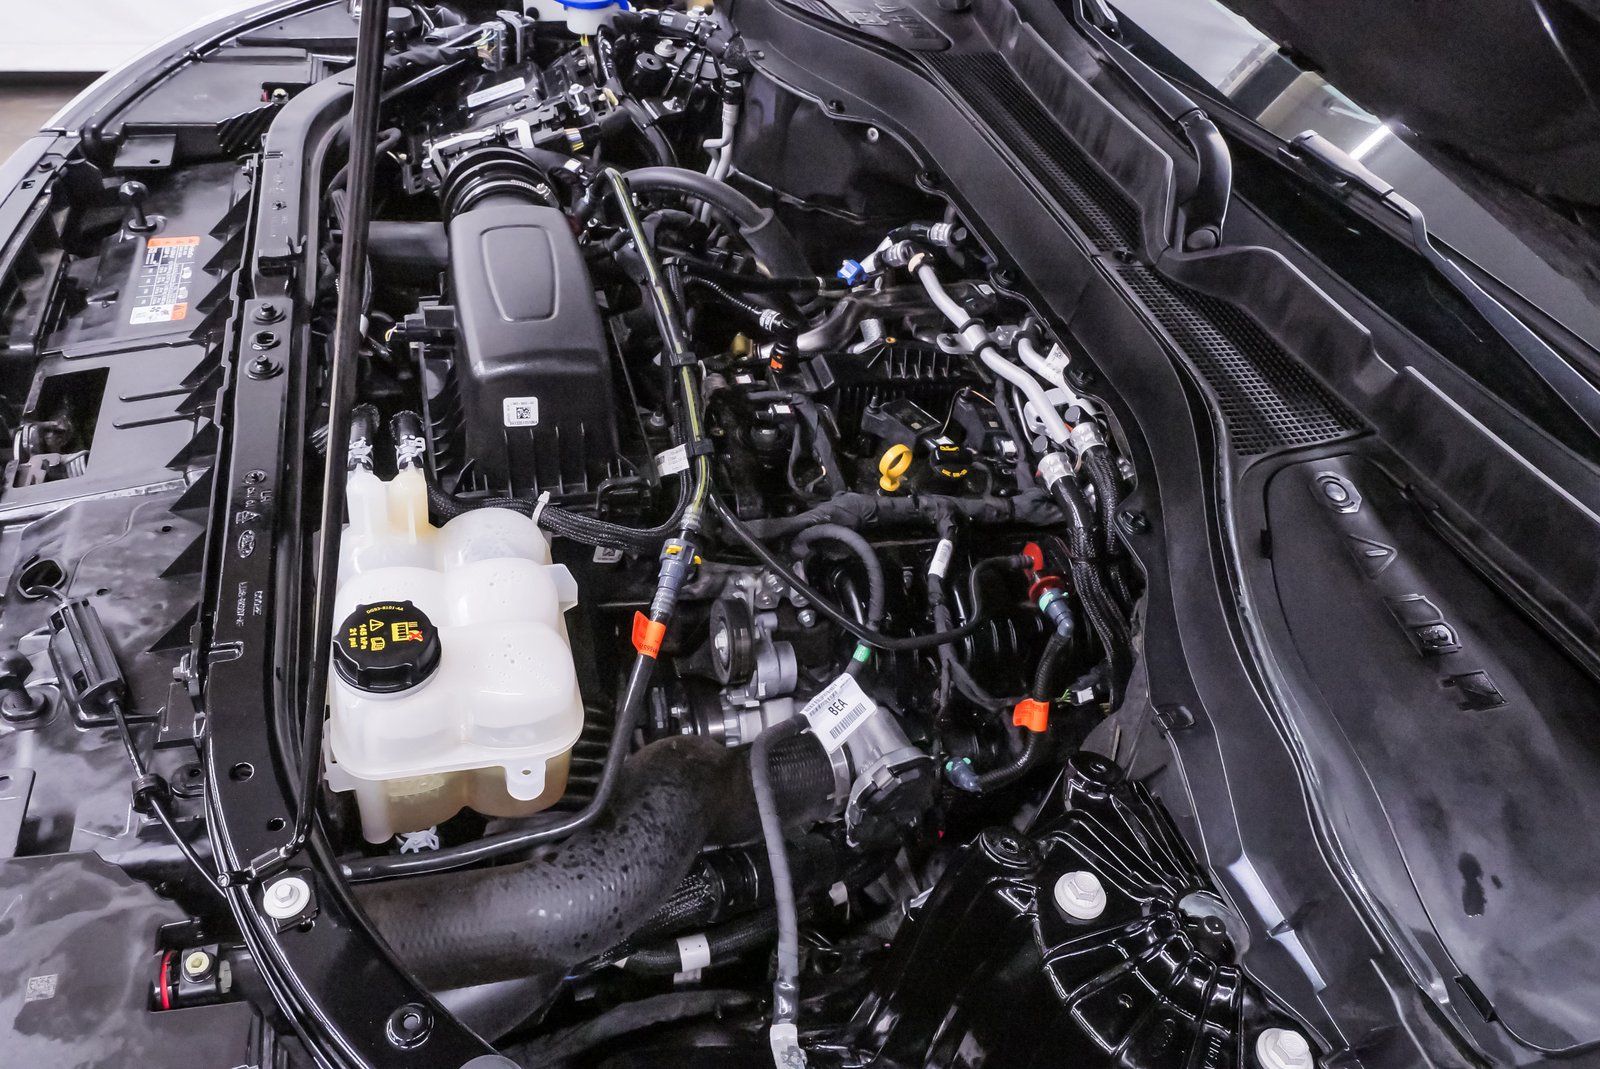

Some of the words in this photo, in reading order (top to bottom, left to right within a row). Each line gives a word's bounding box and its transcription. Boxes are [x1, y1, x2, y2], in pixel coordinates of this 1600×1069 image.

[349, 627, 358, 636] 21
[359, 623, 368, 636] 145
[348, 637, 358, 648] psi
[360, 636, 368, 650] kPa
[827, 698, 849, 716] BEA
